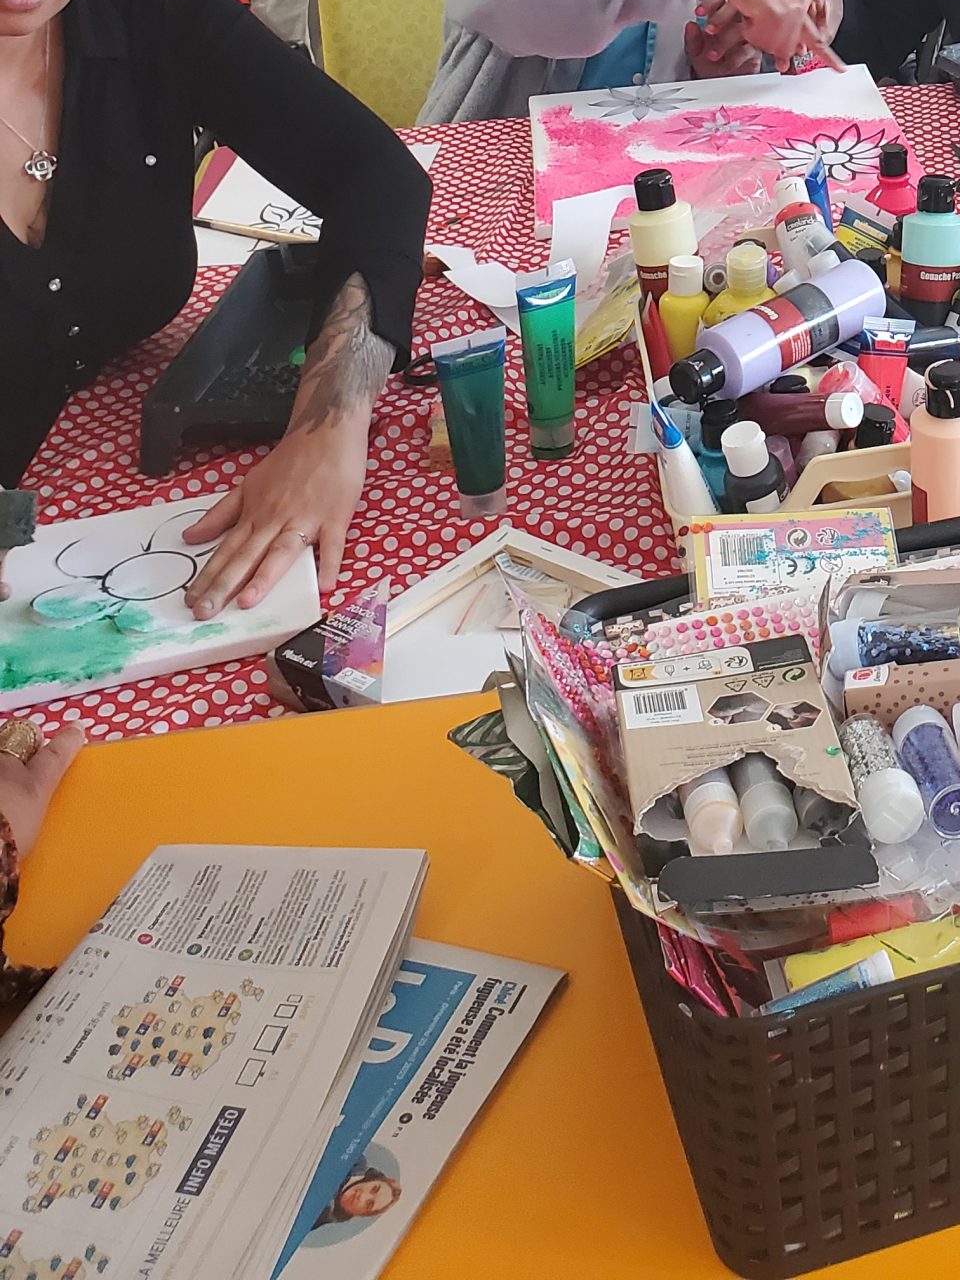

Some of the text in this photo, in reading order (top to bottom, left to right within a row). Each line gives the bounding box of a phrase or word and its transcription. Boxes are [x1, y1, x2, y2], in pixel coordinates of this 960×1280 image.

[920, 271, 951, 281] Gouache
[61, 1027, 93, 1064] Mercredi
[410, 976, 502, 1106] fugueuse a été localisée
[460, 1004, 505, 1059] Comment
[453, 1056, 474, 1071] la
[421, 1068, 466, 1121] joggeuse
[149, 1196, 192, 1265] MEILLEURE
[184, 1158, 213, 1193] INFO
[205, 1109, 239, 1157] MÉTÉO
